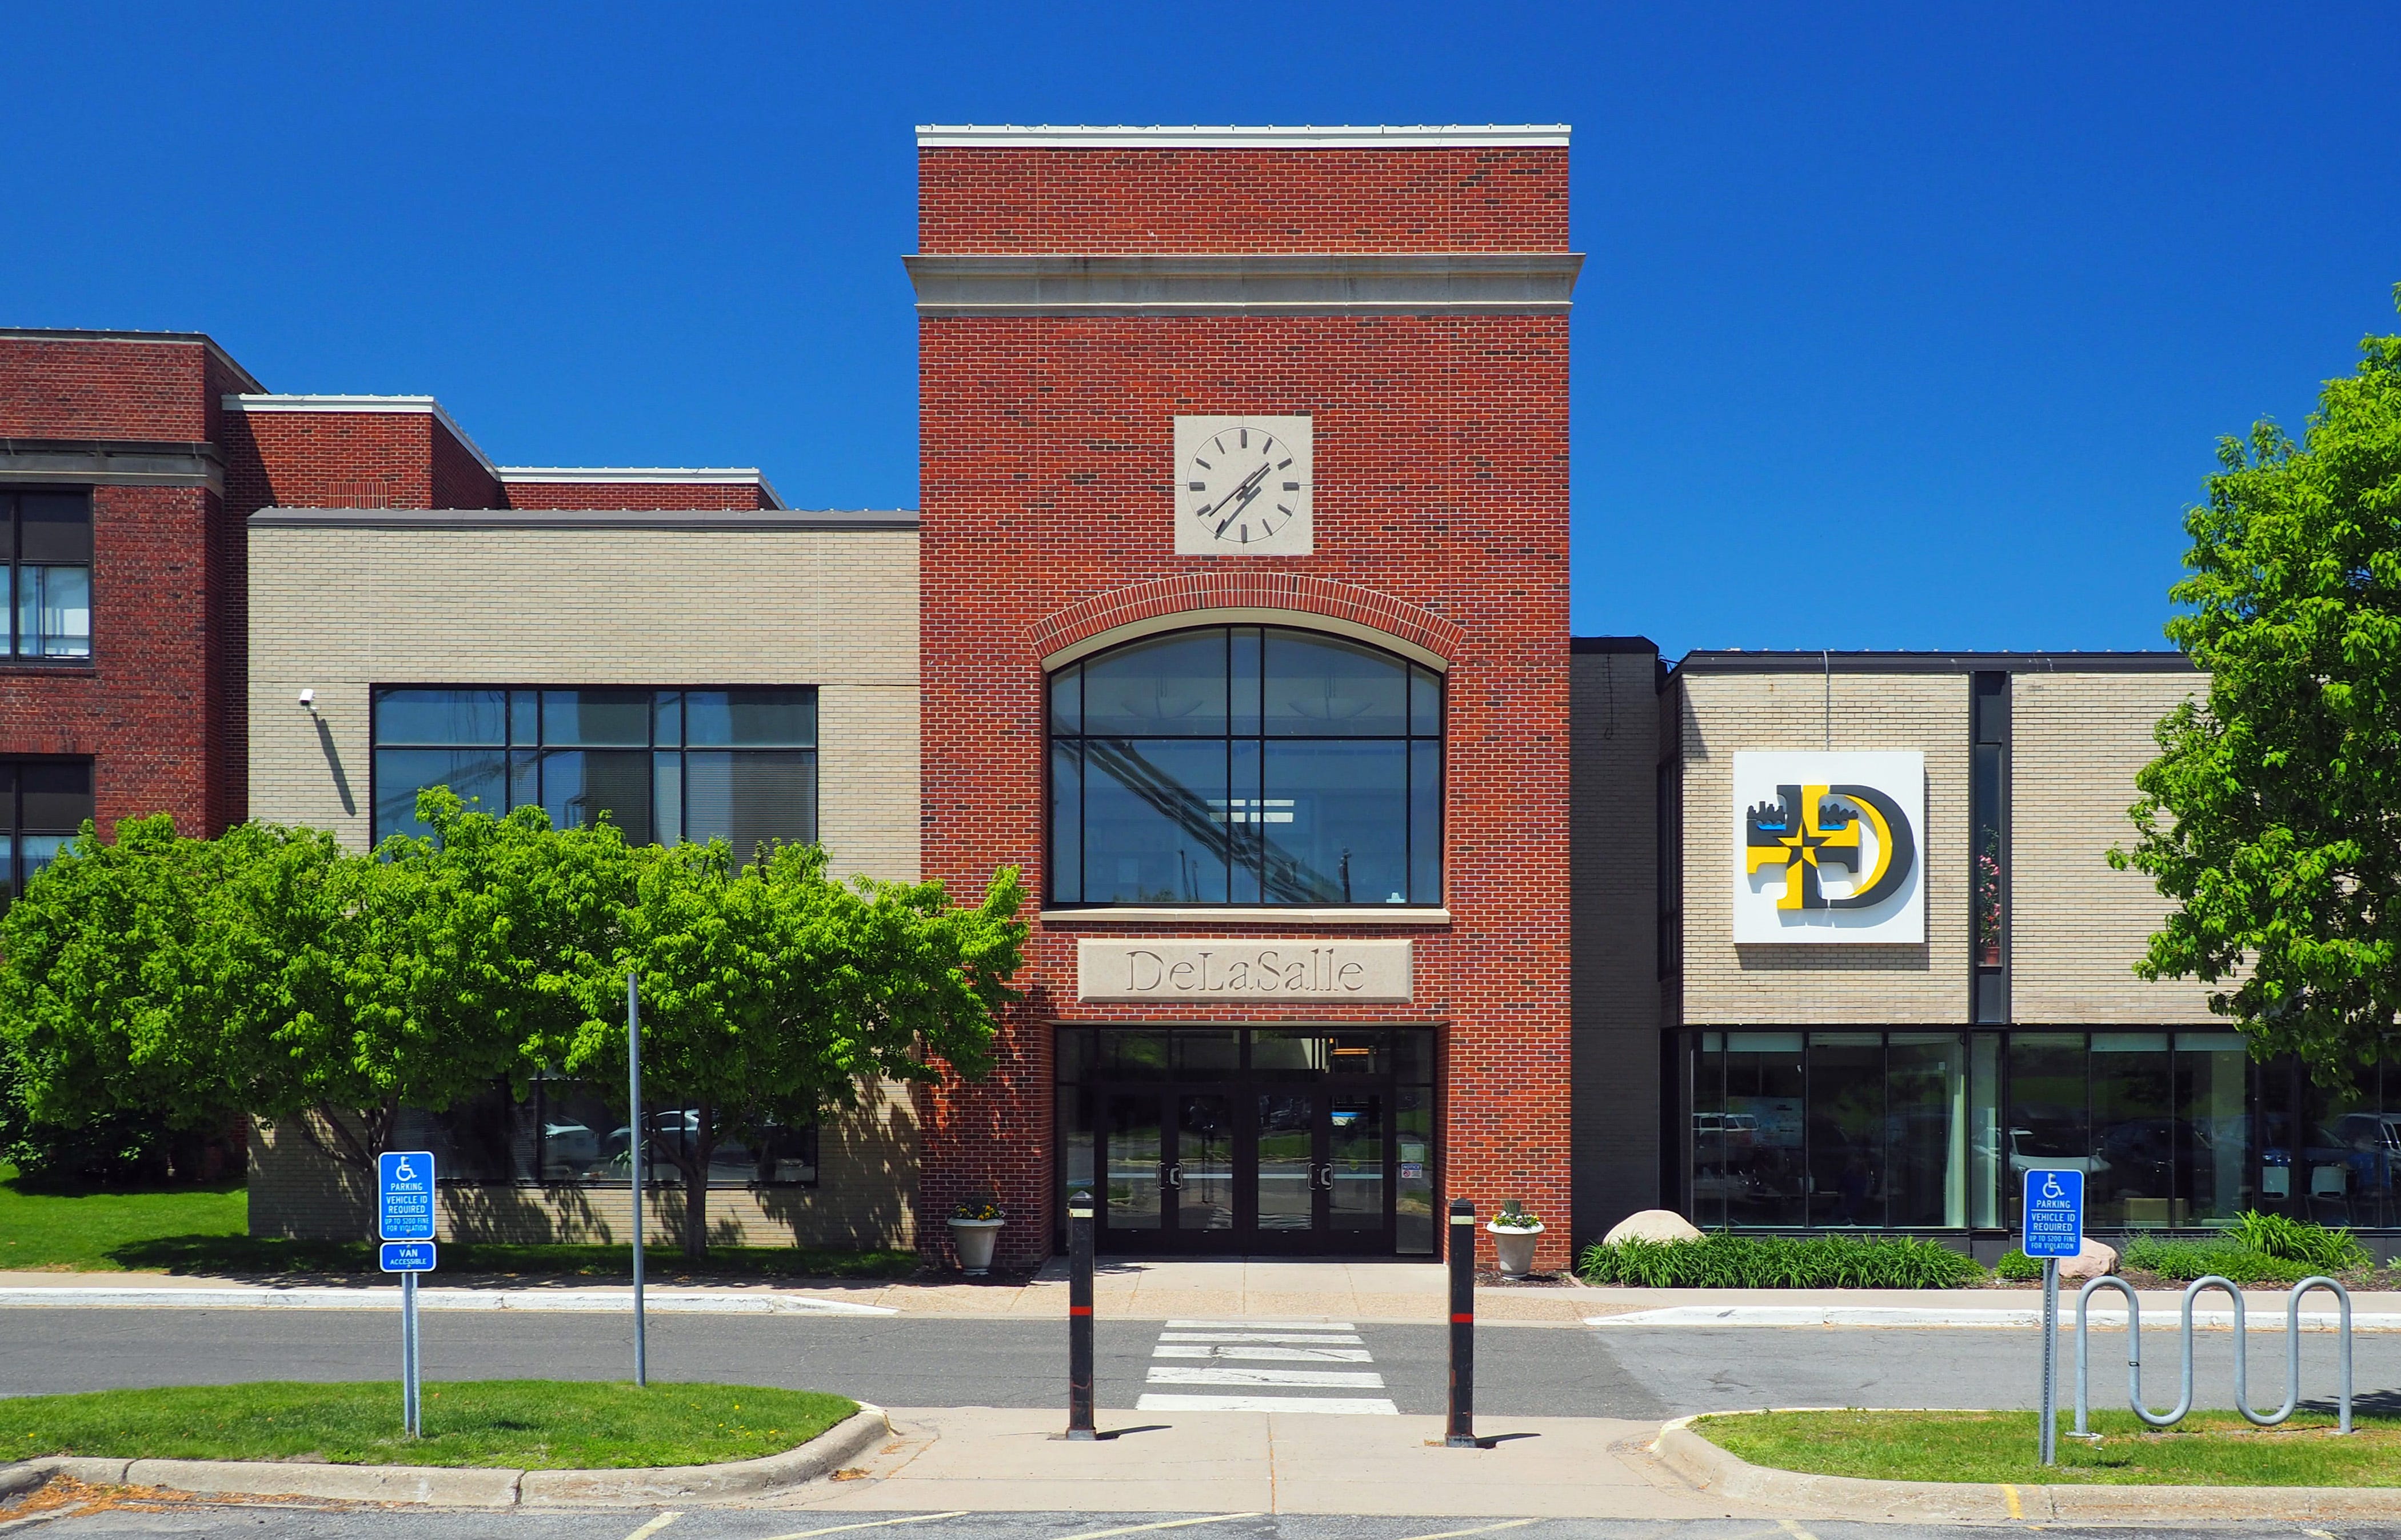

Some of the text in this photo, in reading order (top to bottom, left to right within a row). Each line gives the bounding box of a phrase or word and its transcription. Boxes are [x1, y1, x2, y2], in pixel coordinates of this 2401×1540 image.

[1125, 948, 1364, 991] DeLaSalle
[386, 1196, 417, 1204] VEHICLE
[2036, 1200, 2071, 1208] PARKING
[388, 1205, 425, 1214] REQUIRED
[2034, 1223, 2072, 1231] REQUIRED
[399, 1249, 418, 1257] VAN
